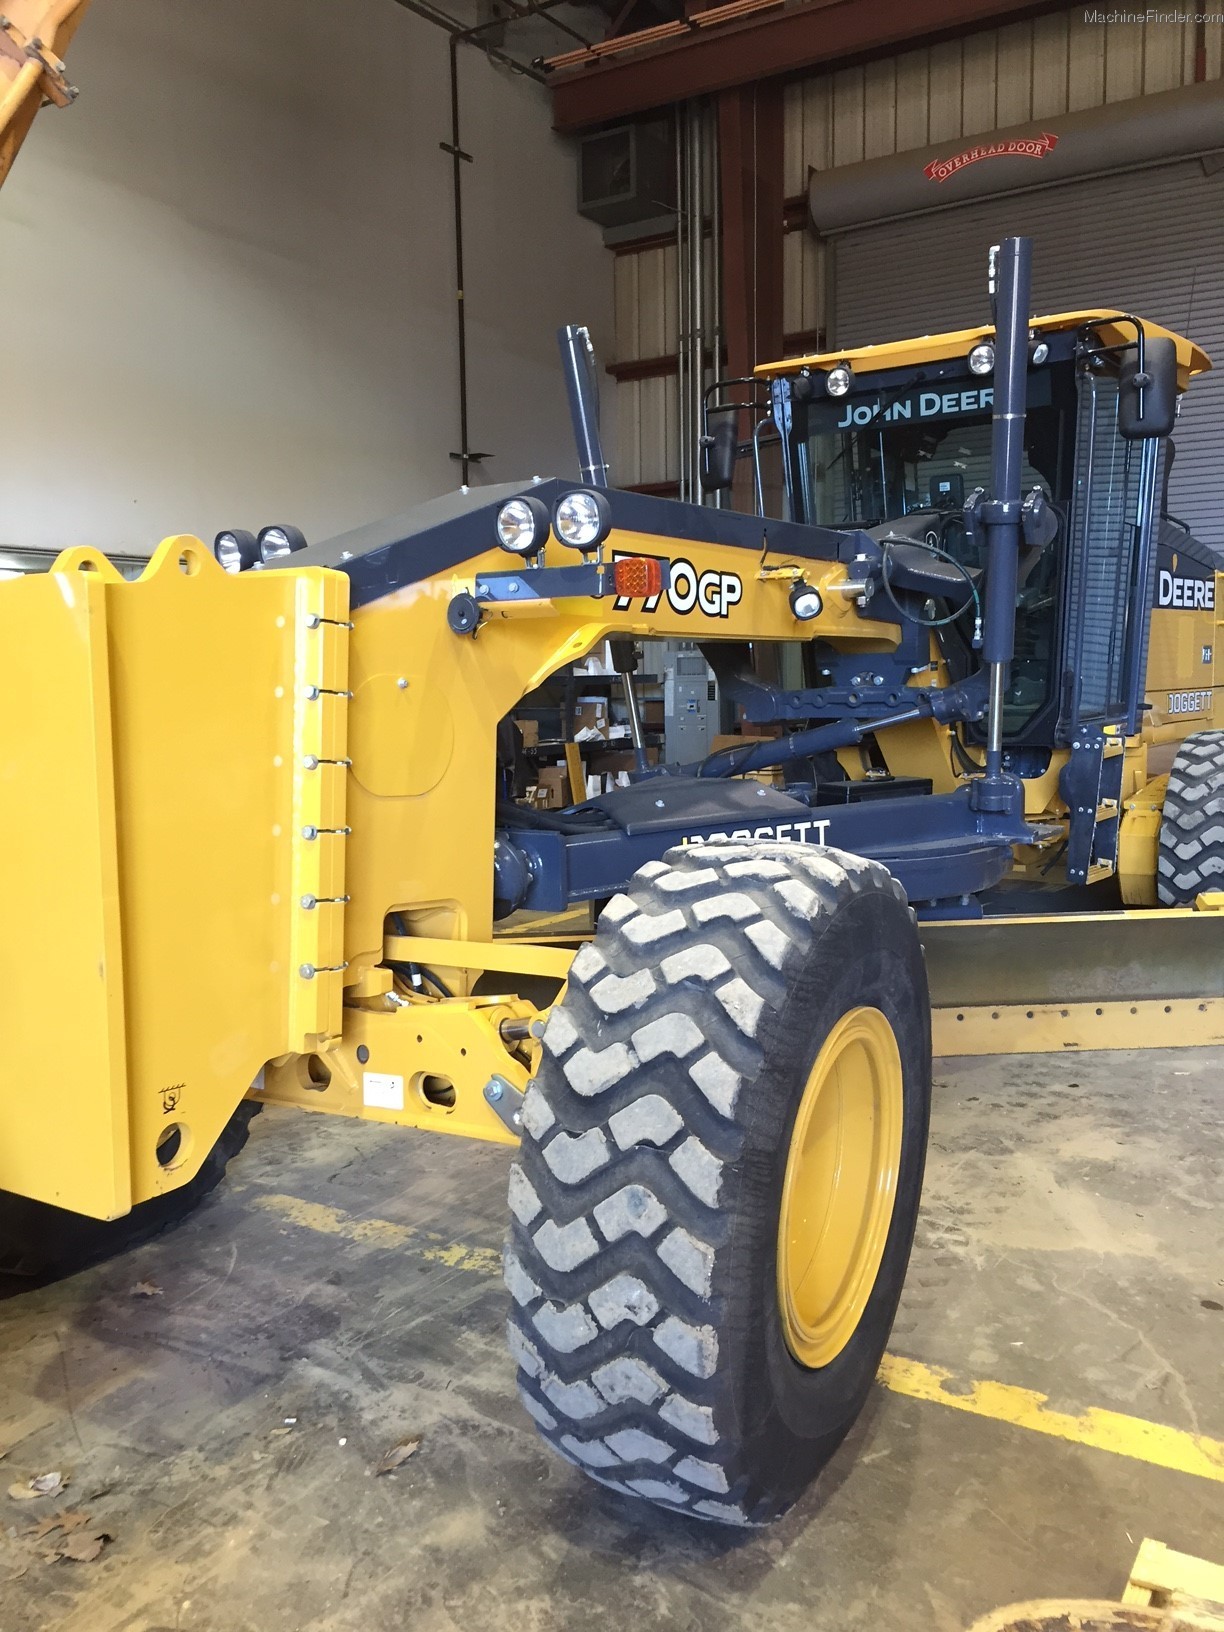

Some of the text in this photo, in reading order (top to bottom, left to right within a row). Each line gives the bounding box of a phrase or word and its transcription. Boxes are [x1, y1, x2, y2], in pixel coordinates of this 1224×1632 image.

[938, 142, 1043, 178] OVERHEAD DOOR
[919, 388, 994, 417] DEER
[1159, 570, 1215, 608] DEERE
